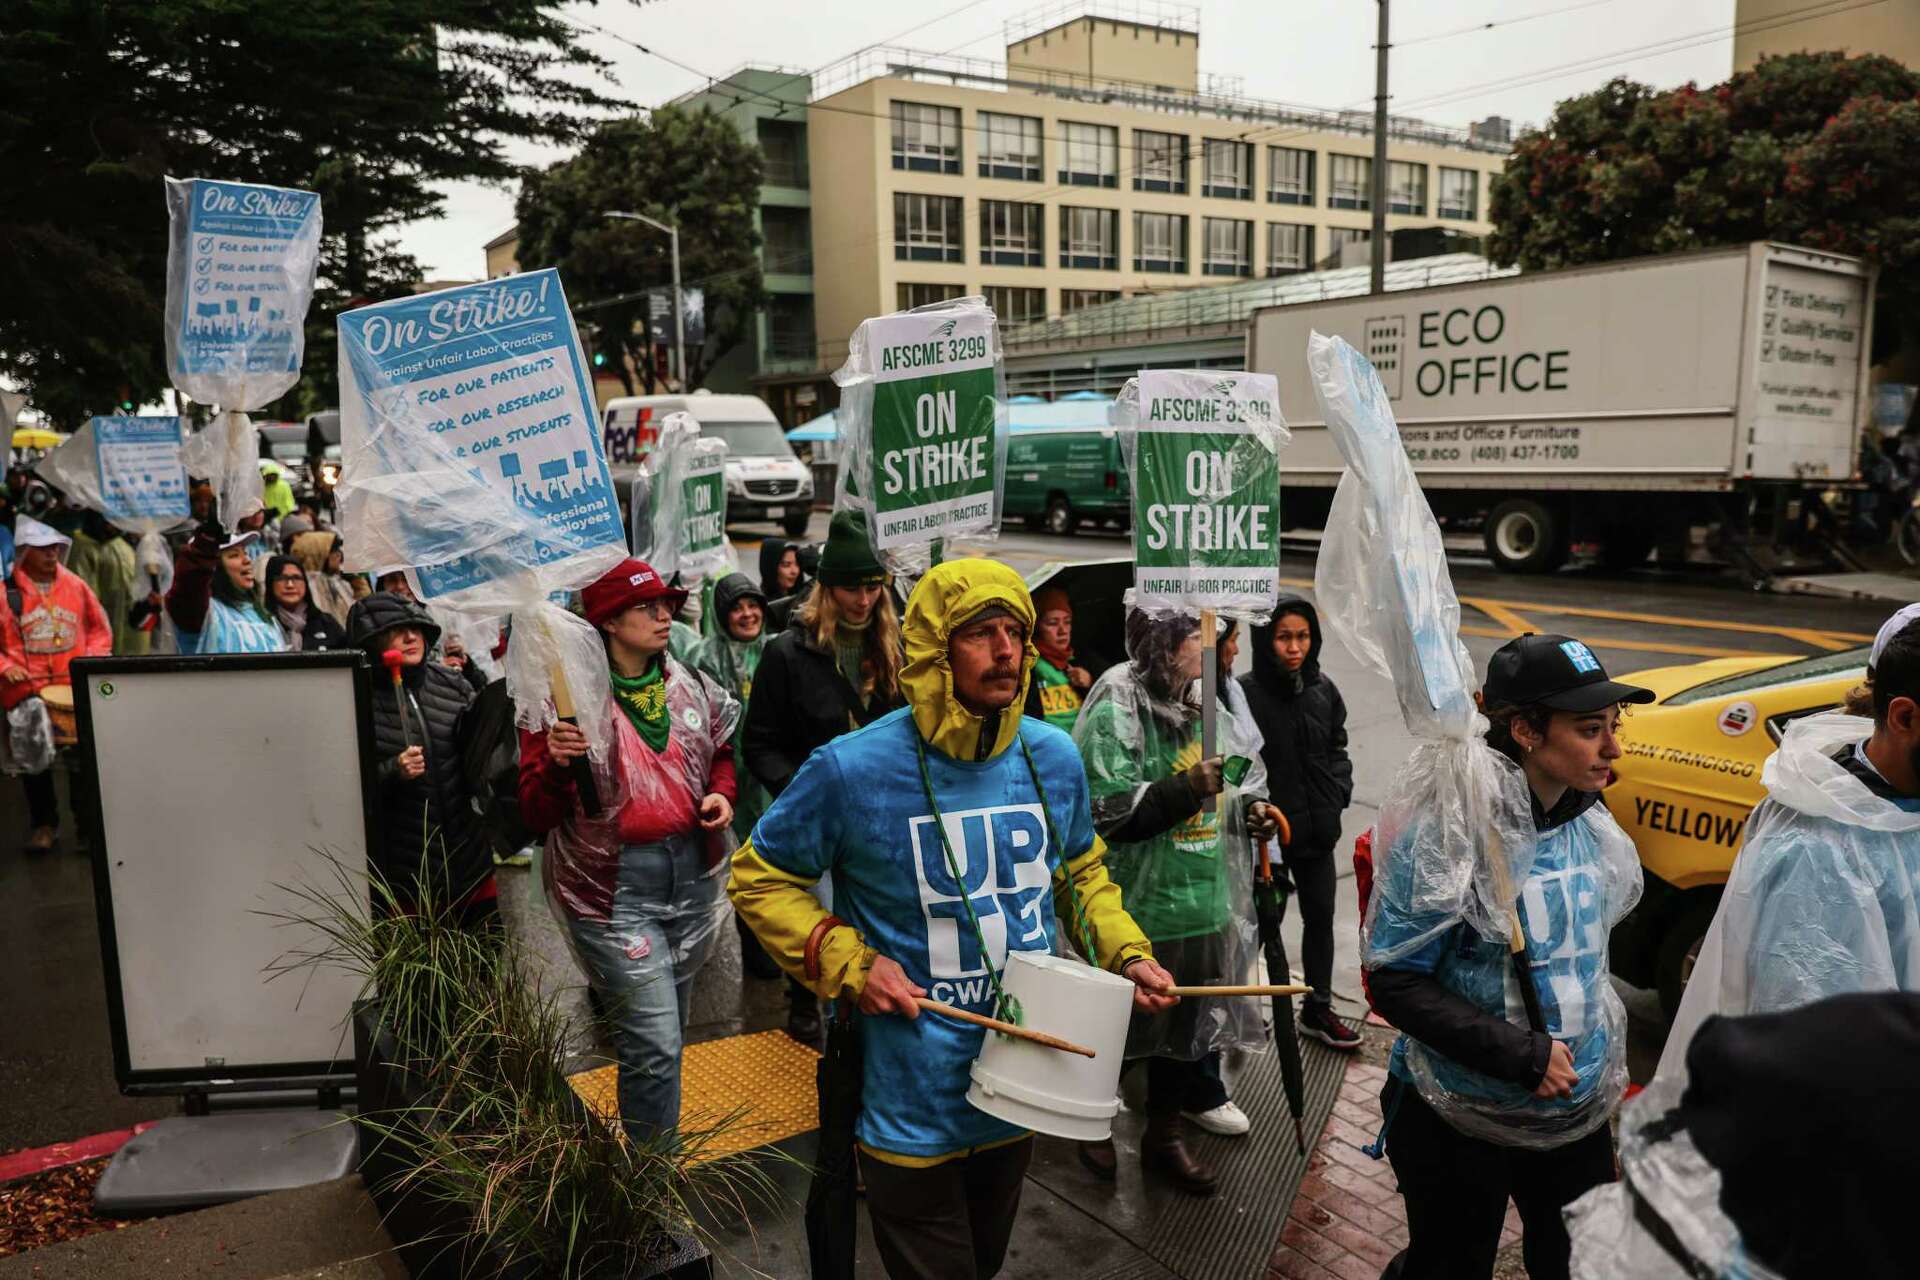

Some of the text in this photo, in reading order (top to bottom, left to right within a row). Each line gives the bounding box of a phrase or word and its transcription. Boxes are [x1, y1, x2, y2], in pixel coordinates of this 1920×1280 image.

[202, 186, 314, 218] On Strike!
[219, 242, 238, 252] FOR
[241, 244, 259, 252] OUR
[362, 277, 550, 357] On Strike!
[1419, 305, 1505, 349] ECO
[382, 331, 554, 379] gainst Unfair Labor Practices
[882, 336, 987, 371] AFSCME 3299
[1416, 351, 1570, 397] OFFICE
[417, 357, 556, 406] FOR OUR PATIENTS
[461, 407, 493, 427] OUR
[497, 385, 566, 416] RESEARCH
[916, 389, 957, 438] ON
[1150, 398, 1222, 422] AFSCME
[472, 435, 503, 455] OUR
[506, 413, 573, 444] STUDENTS
[604, 406, 658, 466] FedE
[1400, 425, 1581, 442] ions and Office Furniture
[1404, 444, 1460, 461] ice.eco
[883, 436, 988, 495] STRIKE
[1186, 450, 1233, 498] ON
[541, 496, 609, 527] ofessional
[695, 484, 712, 513] ON
[555, 510, 612, 534] ployees
[884, 518, 918, 537] UNFAIR
[919, 511, 947, 530] LABOR
[1146, 504, 1270, 551] STRIKE
[1143, 579, 1182, 594] UNFAIR
[1222, 579, 1272, 594] PRACTICE
[1624, 742, 1756, 777] SAN FRANCISCO
[1635, 796, 1744, 848] YELLOW
[913, 808, 1046, 897] UP
